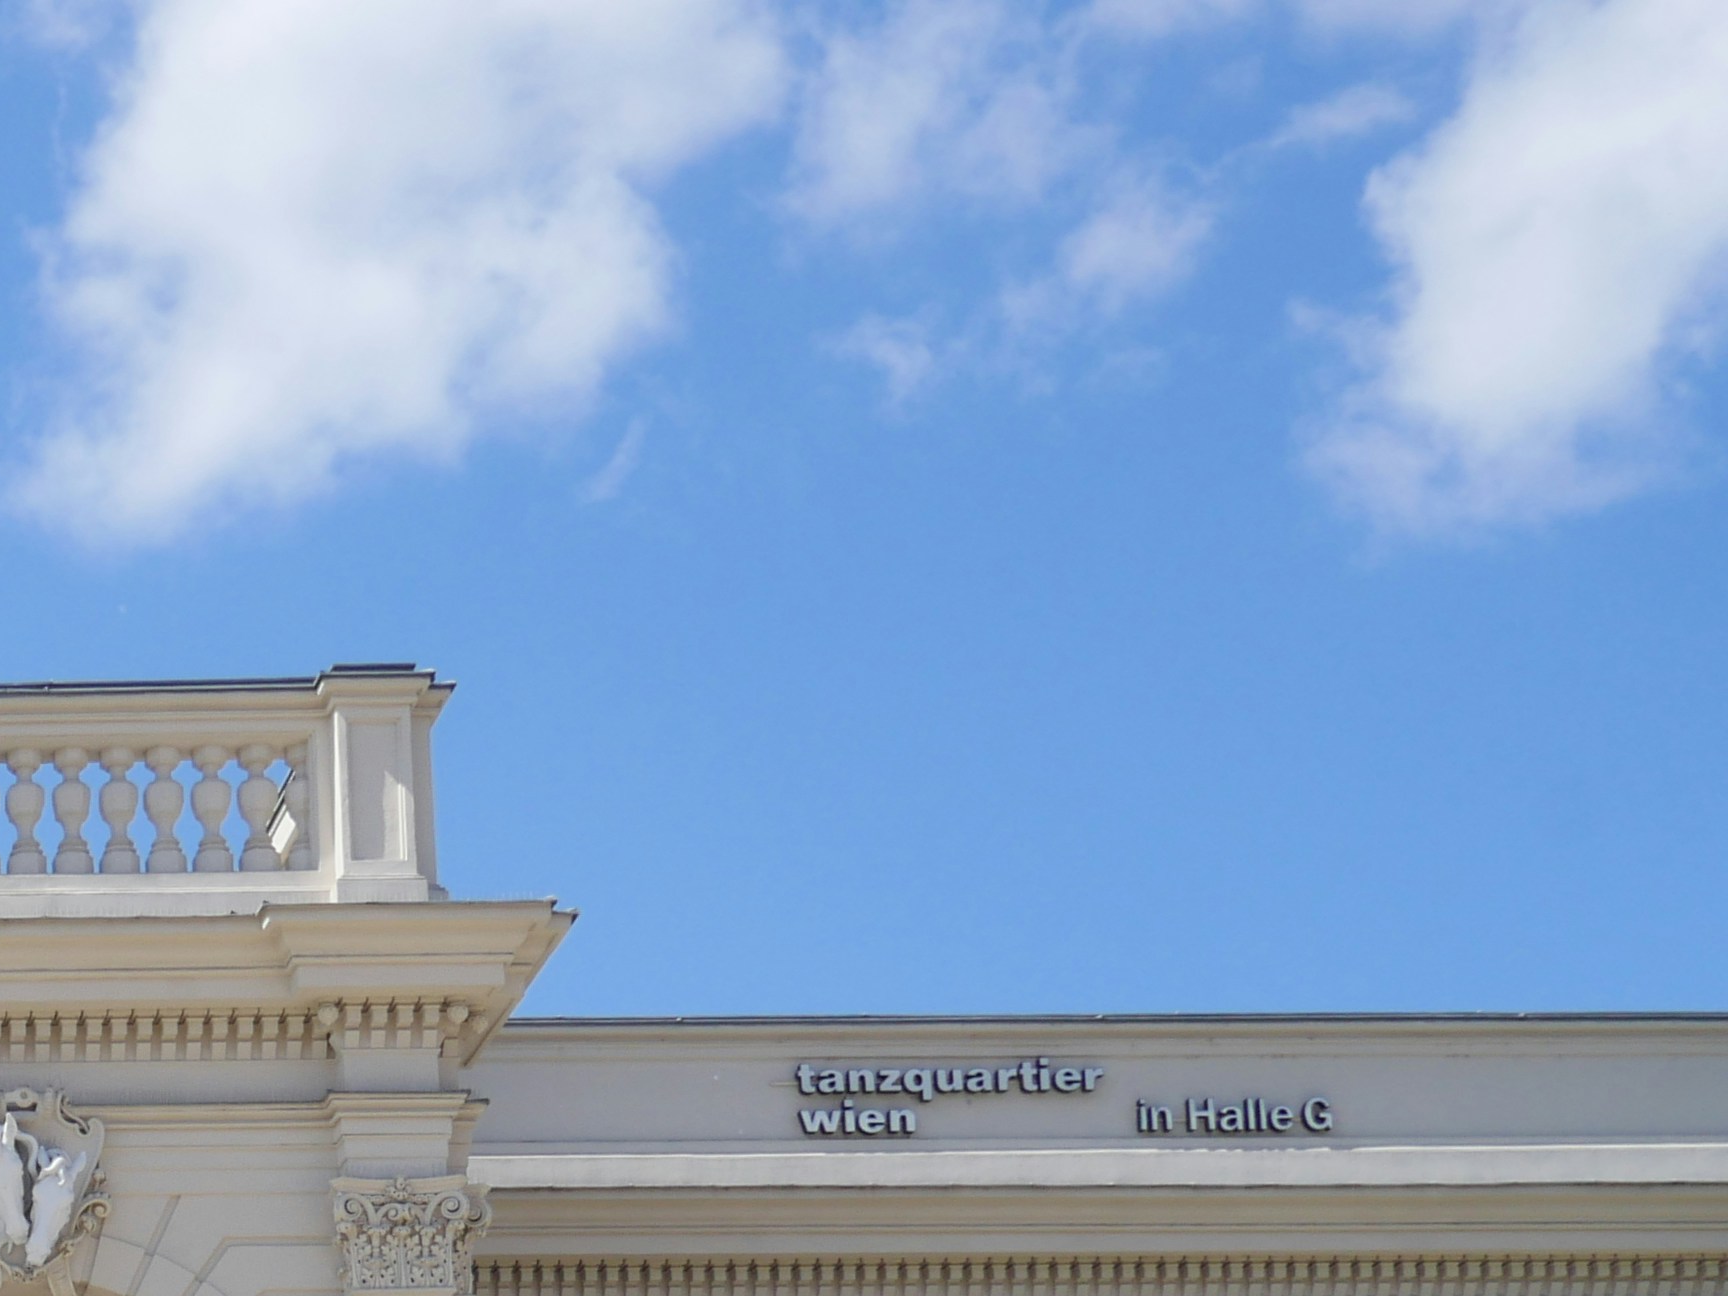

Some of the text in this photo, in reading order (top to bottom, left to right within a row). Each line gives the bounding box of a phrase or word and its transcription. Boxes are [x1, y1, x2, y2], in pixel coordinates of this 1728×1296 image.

[795, 1058, 1104, 1103] tanzquartier
[798, 1099, 917, 1134] wien
[1137, 1097, 1333, 1132] in Halle G
